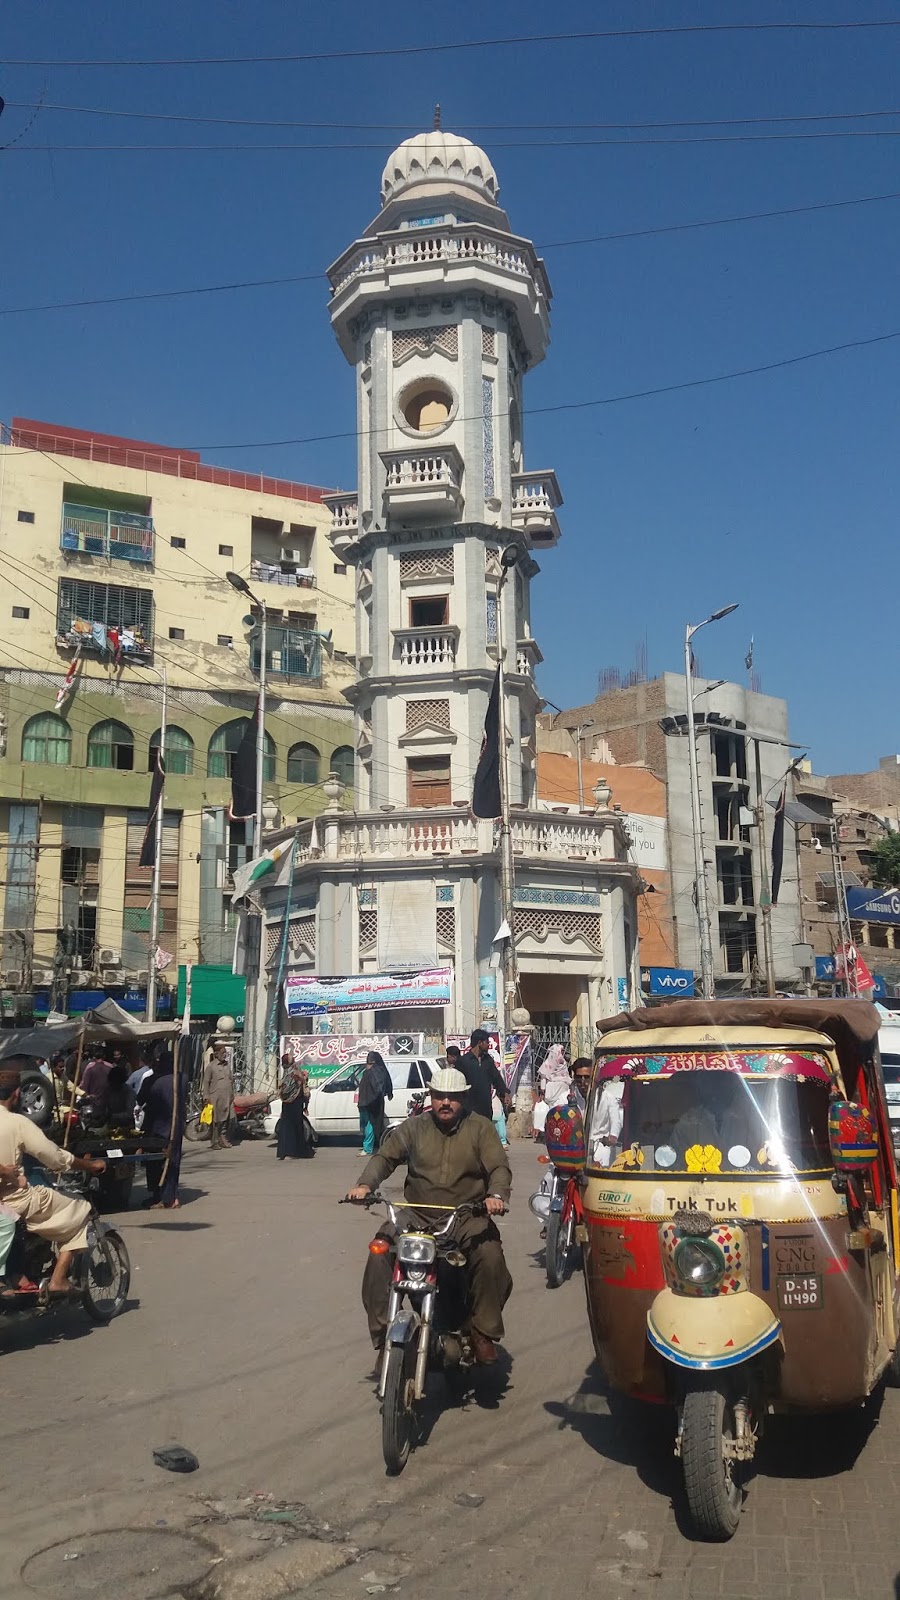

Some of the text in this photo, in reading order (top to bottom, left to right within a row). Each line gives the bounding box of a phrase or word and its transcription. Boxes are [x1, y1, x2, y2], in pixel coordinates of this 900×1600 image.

[624, 821, 644, 833] elfie
[638, 840, 655, 851] you
[865, 901, 892, 914] SAMSUNG
[658, 974, 688, 988] vivo
[598, 1192, 621, 1202] EURO
[667, 1197, 738, 1212] Tuk Tuk
[775, 1247, 816, 1263] CNG
[786, 1279, 818, 1291] D-15
[783, 1293, 818, 1305] 11490
